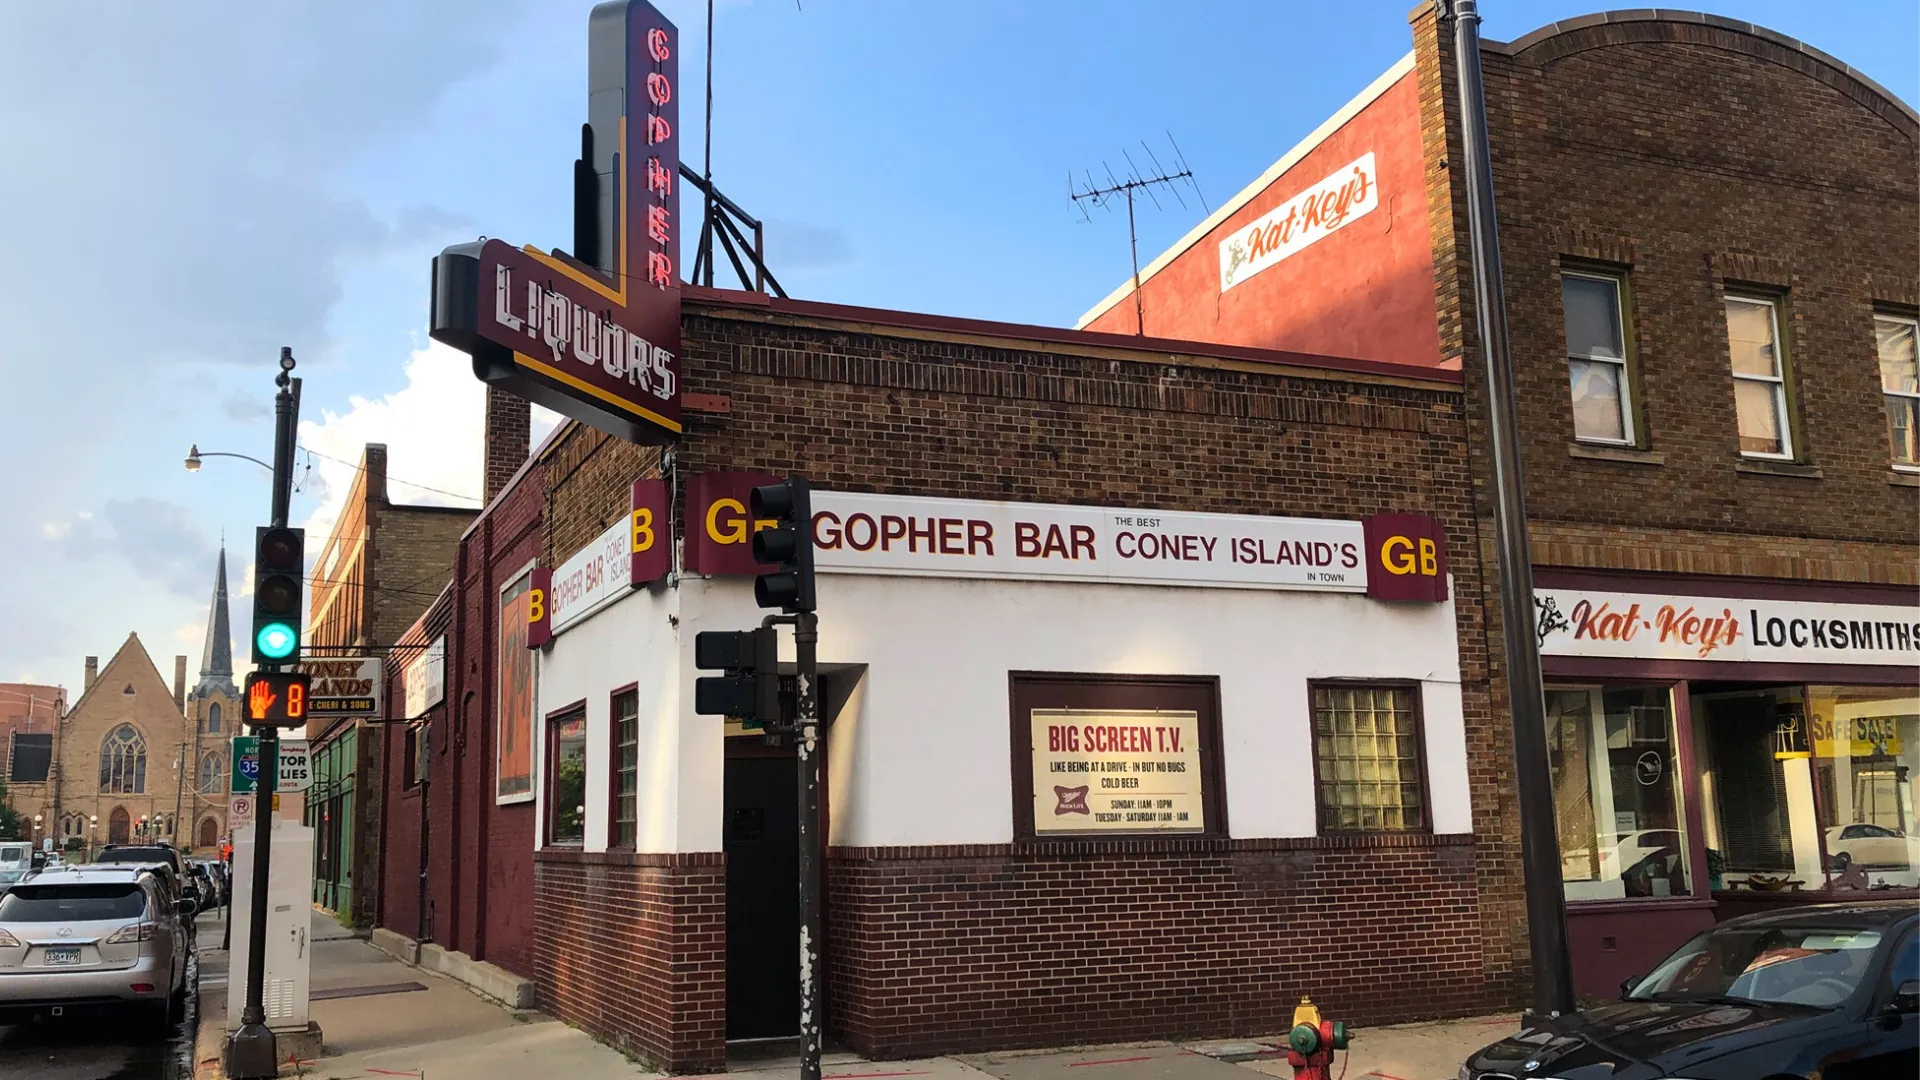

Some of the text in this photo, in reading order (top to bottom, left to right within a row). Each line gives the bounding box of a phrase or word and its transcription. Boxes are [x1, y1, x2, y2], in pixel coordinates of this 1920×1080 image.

[647, 28, 671, 291] GOPHER
[496, 263, 676, 400] LIQUORS
[811, 510, 1097, 561] GOPHER BAR
[1115, 516, 1161, 528] THE BEST
[605, 533, 627, 564] CONEY
[1115, 531, 1358, 568] CONEY ISLAND'S
[1380, 535, 1438, 577] GB
[552, 554, 604, 615] GOPHER BAR
[1307, 572, 1345, 582] IN TOWN
[1048, 725, 1184, 753] BIG SCREEN T.V.
[1812, 714, 1851, 741] SAFE
[280, 756, 307, 766] TOR
[280, 769, 308, 779] LIES
[1050, 761, 1066, 773] LIKE
[1068, 761, 1089, 773] BEING
[1090, 761, 1100, 773] AT
[1100, 761, 1106, 773] A
[1107, 762, 1127, 773] DRIVE
[1133, 761, 1141, 773] IN
[1142, 761, 1155, 773] BUT
[1156, 761, 1166, 773] NO
[1167, 762, 1186, 773] BUGS
[1101, 778, 1139, 789] COLD BEER
[1095, 812, 1122, 823] TUESDAY
[1126, 812, 1157, 822] SATURDAY
[1157, 812, 1172, 822] 11AM
[1176, 812, 1189, 821] 1AM
[1111, 799, 1137, 809] SUNDAY:
[1137, 799, 1152, 809] 11AM
[1156, 799, 1172, 809] 10PM
